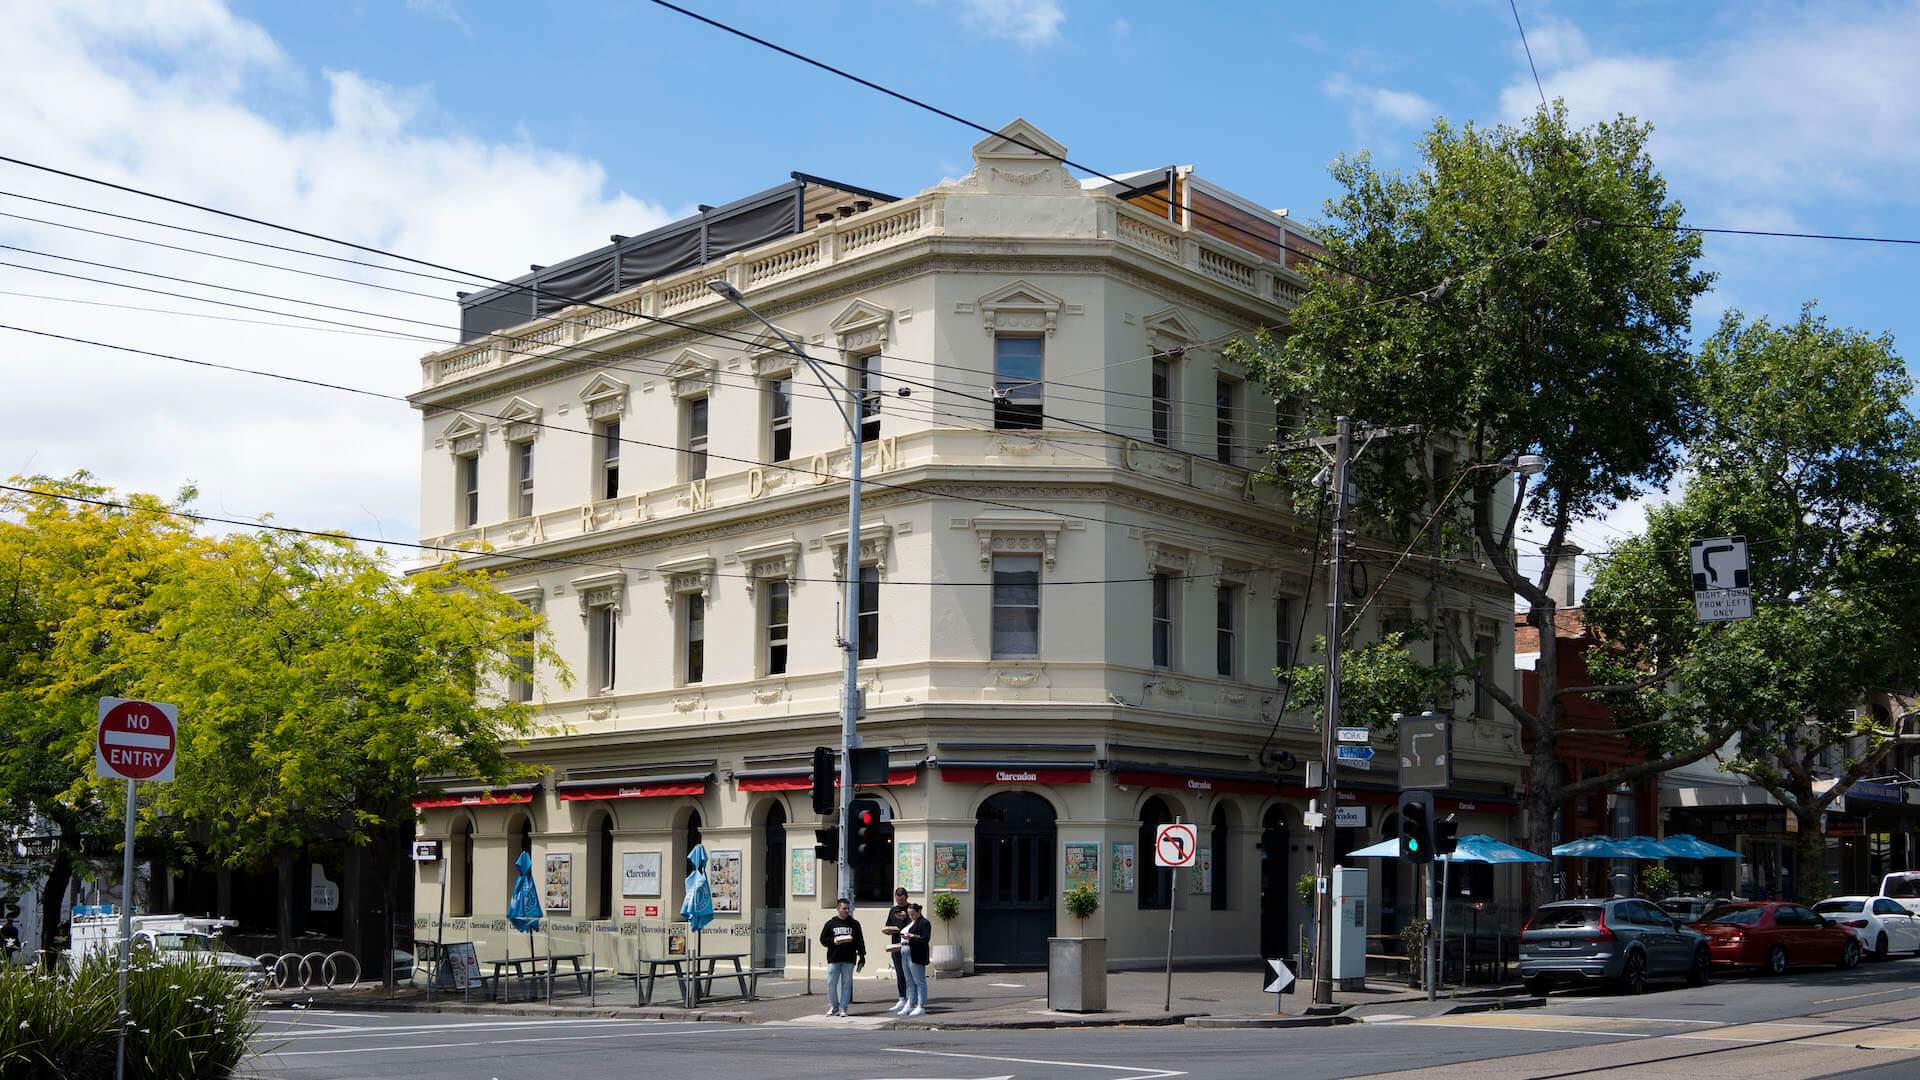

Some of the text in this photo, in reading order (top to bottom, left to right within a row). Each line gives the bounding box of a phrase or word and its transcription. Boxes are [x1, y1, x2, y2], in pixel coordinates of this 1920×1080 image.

[1696, 591, 1720, 600] RIGHT
[1727, 598, 1747, 607] LEFT
[1713, 609, 1734, 617] ONLY
[127, 713, 150, 730] NO
[110, 748, 164, 768] ENTRY
[995, 771, 1037, 781] Clarendon
[1335, 812, 1358, 821] rendon
[626, 868, 657, 879] Clarendon
